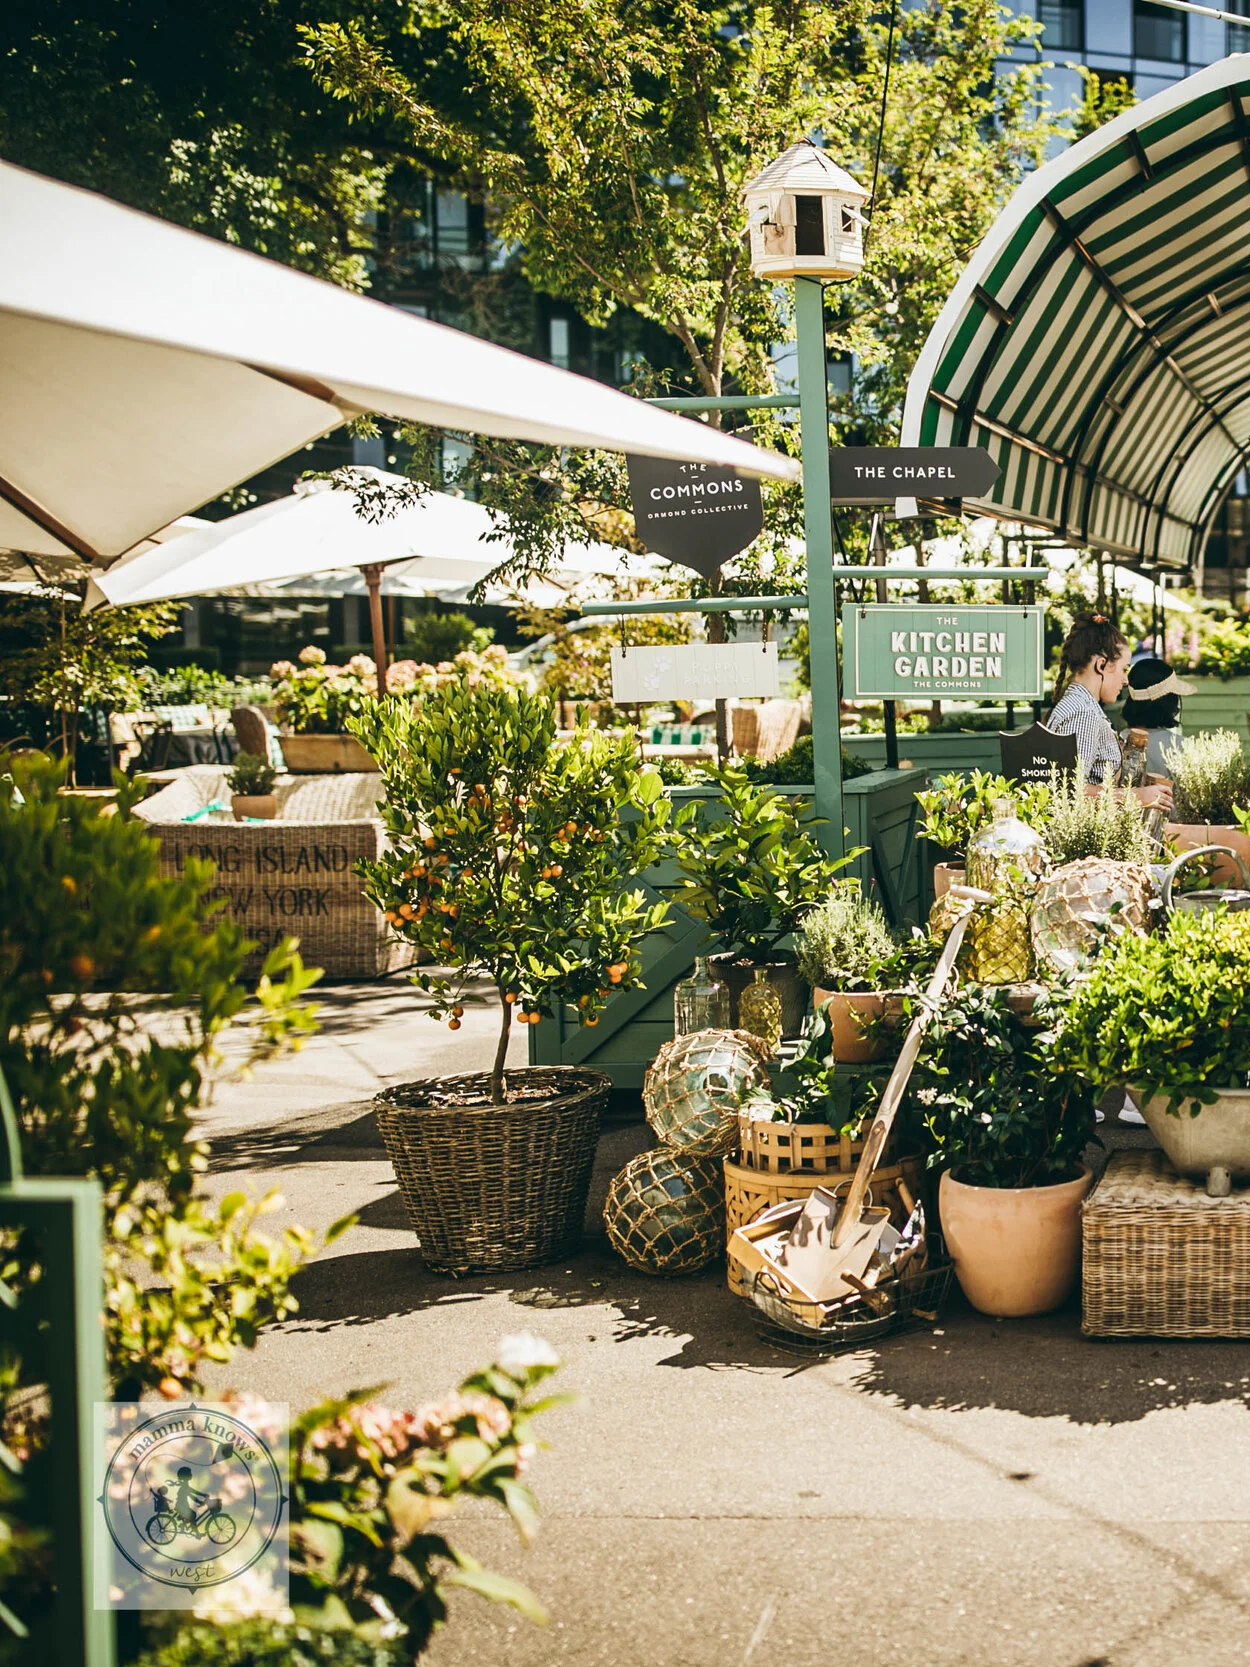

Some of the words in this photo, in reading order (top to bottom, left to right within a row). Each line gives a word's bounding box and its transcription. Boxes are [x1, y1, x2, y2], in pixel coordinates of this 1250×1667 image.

[680, 463, 707, 473] THE
[854, 466, 886, 478] THE
[892, 466, 956, 478] CHAPEL
[650, 479, 744, 500] COMMONS
[647, 510, 687, 519] ORMOND
[691, 503, 749, 515] COLLECTIVE
[936, 617, 959, 626] THE
[891, 631, 1006, 654] KITCHEN
[894, 656, 1003, 678] GARDEN
[1032, 756, 1048, 765] NO
[255, 844, 348, 874] ISLAND
[263, 888, 330, 916] YORK
